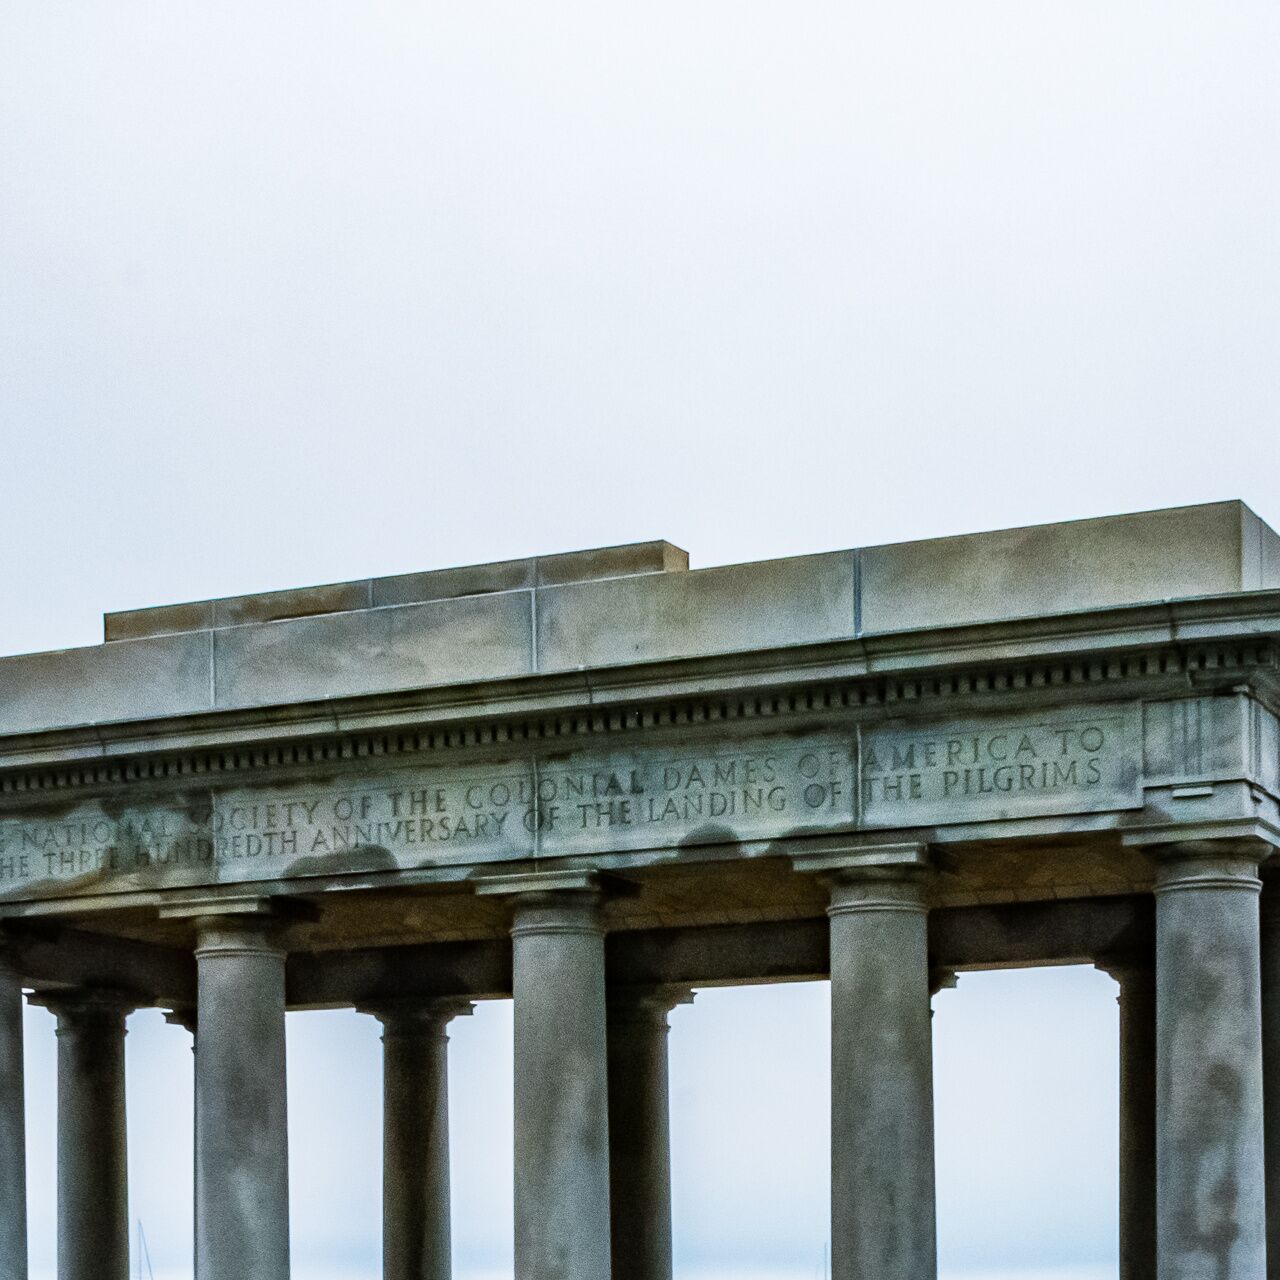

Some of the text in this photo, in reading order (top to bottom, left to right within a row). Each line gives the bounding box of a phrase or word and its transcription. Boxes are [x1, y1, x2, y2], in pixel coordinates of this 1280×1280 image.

[22, 817, 171, 848] NATIONAL
[191, 802, 319, 836] SOCIETY
[334, 794, 372, 821] OF
[389, 788, 446, 816] THE
[466, 768, 644, 808] COLONIAL
[662, 757, 775, 791] DAMES
[799, 752, 841, 778] OF
[862, 734, 1039, 772] AMERICA
[1055, 727, 1104, 756] TO
[43, 846, 118, 875] THREE
[135, 829, 296, 865] HUNDREDTH
[311, 811, 508, 851] ANNIVERSARY
[523, 808, 559, 833] OF
[577, 800, 631, 828] THE
[647, 785, 786, 823] LANDING
[805, 781, 841, 808] OF
[863, 774, 922, 803] THE
[943, 757, 1102, 796] PILGRIMS
